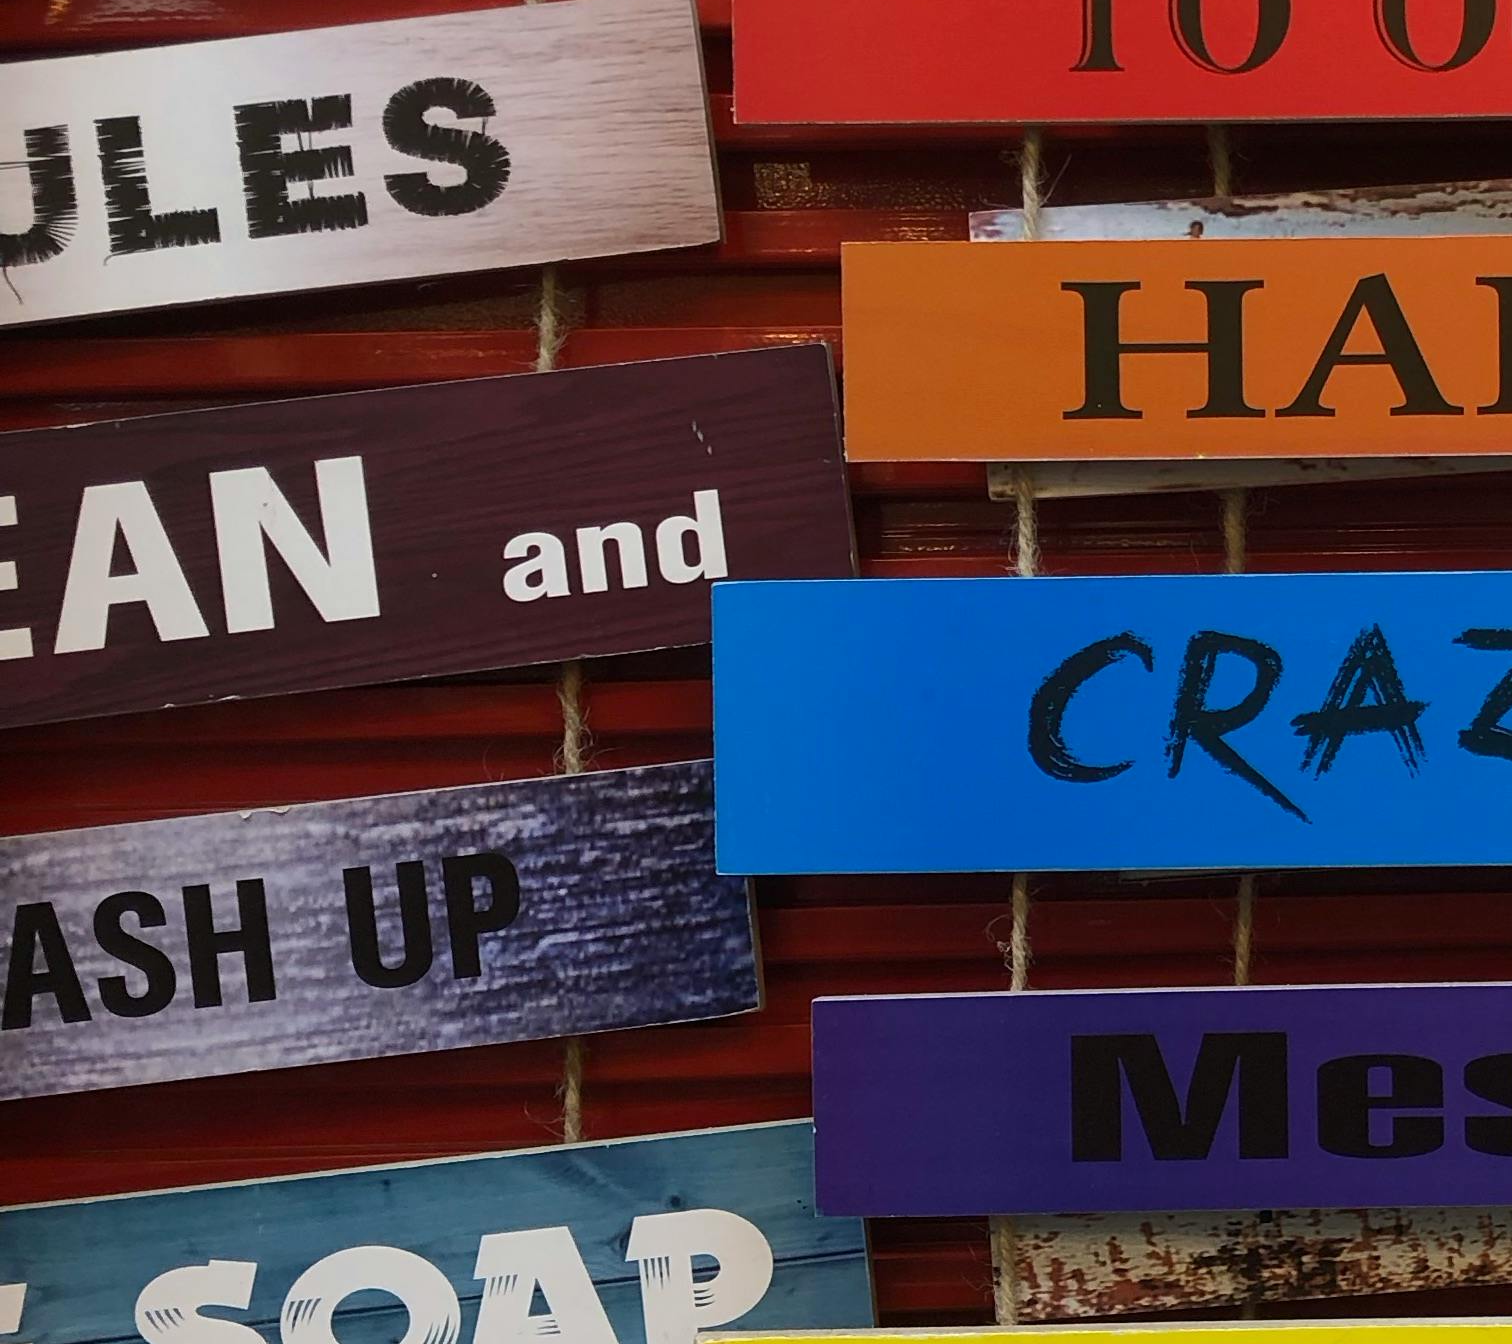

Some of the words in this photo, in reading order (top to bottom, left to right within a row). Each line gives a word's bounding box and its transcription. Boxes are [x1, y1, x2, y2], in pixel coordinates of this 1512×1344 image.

[502, 489, 728, 602] and
[2, 877, 277, 1031] ASH
[342, 853, 521, 989] UP
